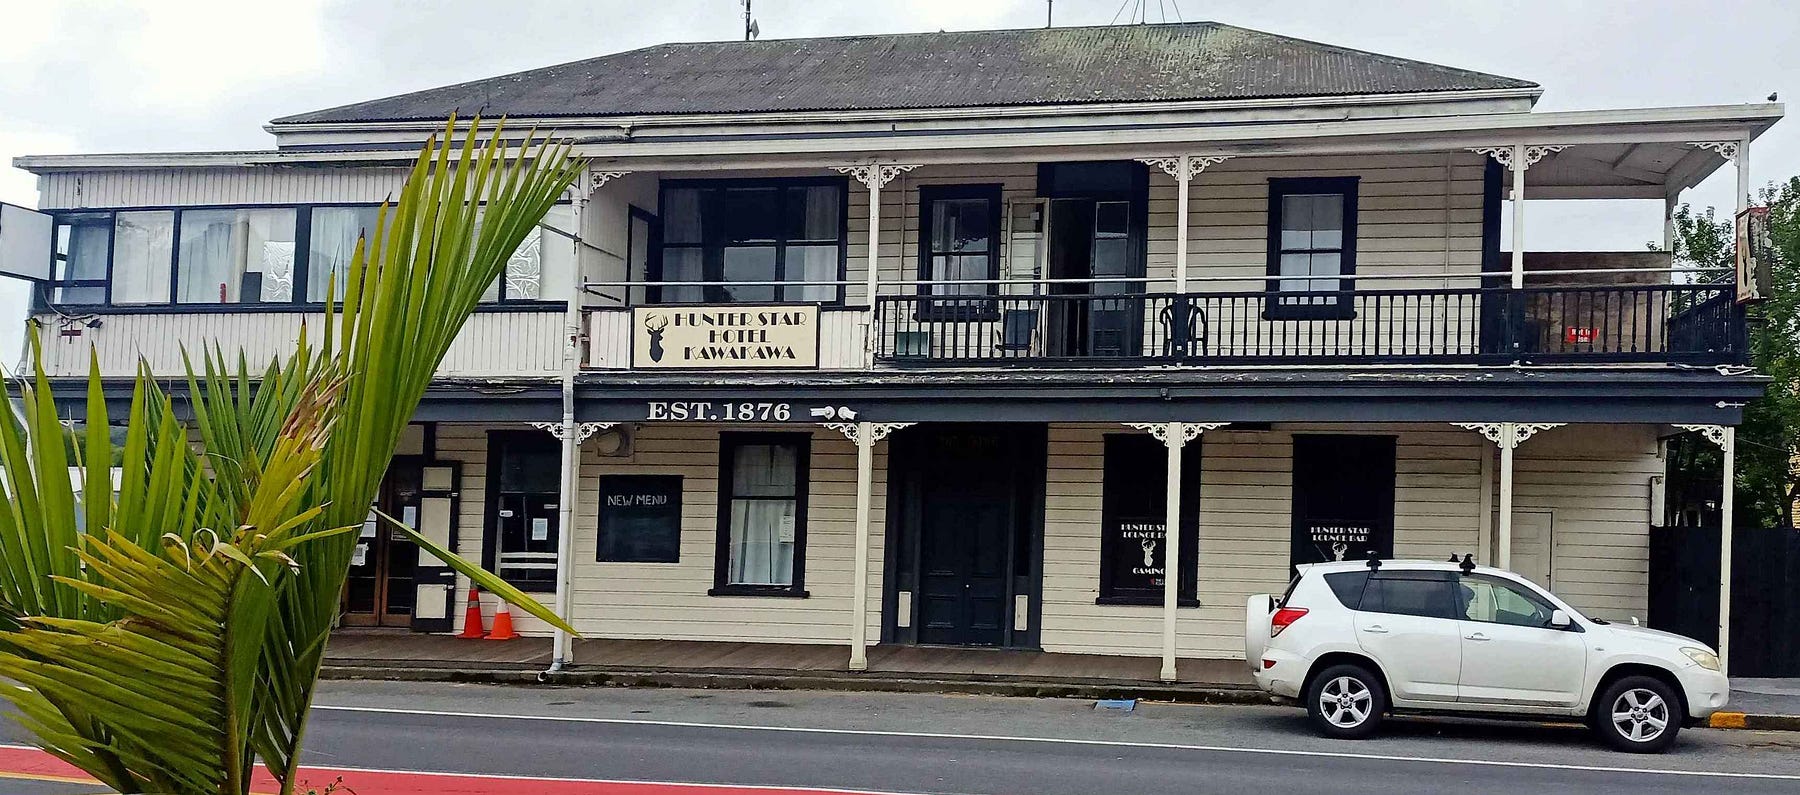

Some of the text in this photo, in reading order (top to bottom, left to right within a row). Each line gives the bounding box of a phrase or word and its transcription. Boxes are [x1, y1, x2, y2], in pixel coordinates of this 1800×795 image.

[674, 312, 807, 327] HUNTER STAR
[708, 329, 772, 344] HOTEL
[683, 345, 796, 361] KAWAKAWA
[607, 494, 667, 506] NEW MENU
[1120, 523, 1167, 532] HUNTER ST
[1310, 526, 1371, 535] HUNTER STAR
[1122, 531, 1156, 539] LOUNGE
[1312, 534, 1348, 542] LOUNGE
